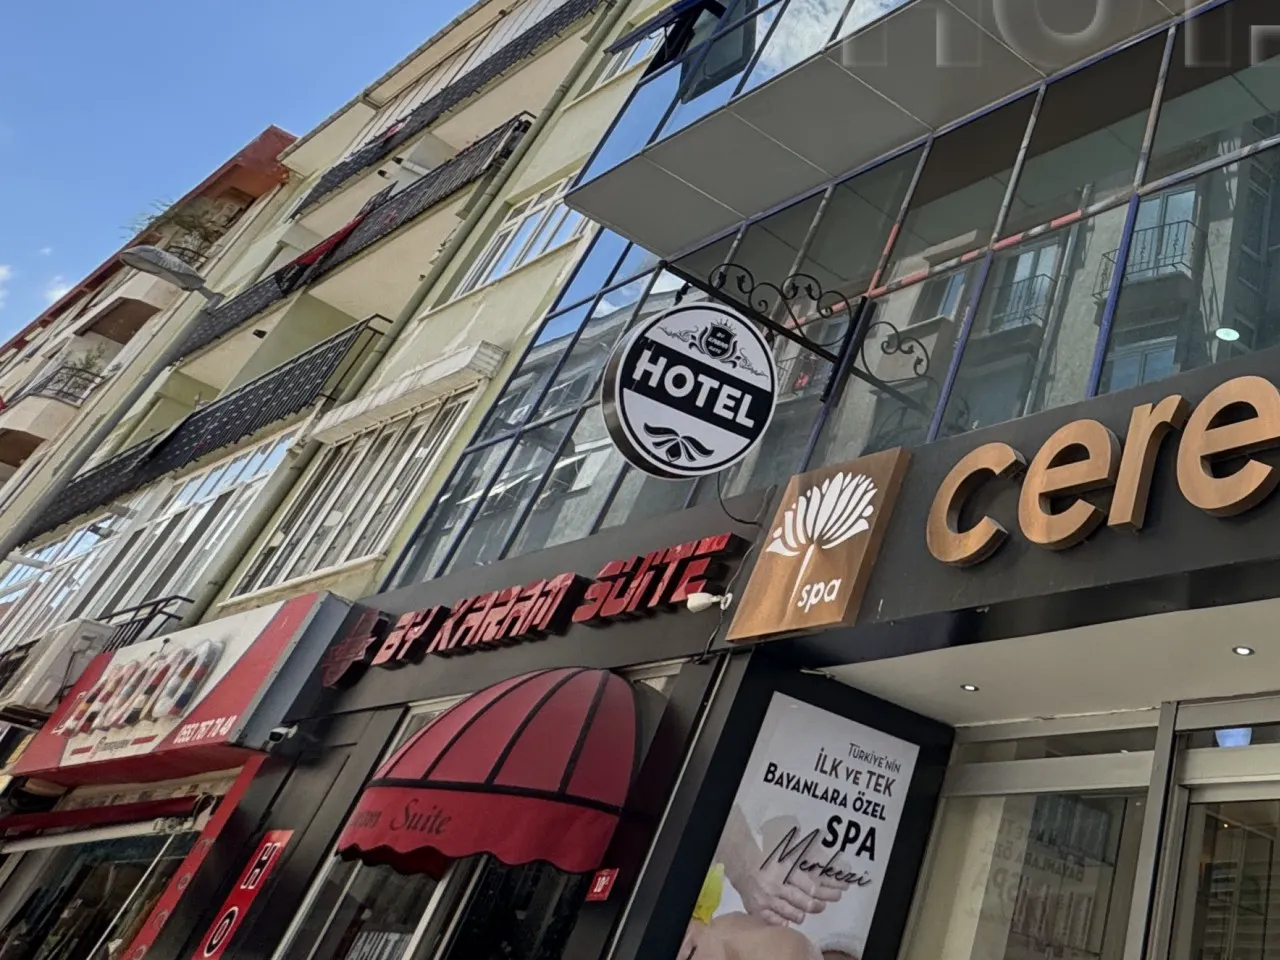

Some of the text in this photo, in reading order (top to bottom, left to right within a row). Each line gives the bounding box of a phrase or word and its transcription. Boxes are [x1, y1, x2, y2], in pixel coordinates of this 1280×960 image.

[632, 348, 755, 429] HOTEL
[370, 532, 735, 667] BY KARAM SUITE
[797, 578, 842, 614] spa
[814, 747, 843, 779] İLK
[866, 770, 896, 797] TEK
[389, 798, 452, 835] Suite
[852, 791, 887, 821] ÖZEL
[759, 826, 872, 887] Merkezi
[821, 814, 877, 861] SPA
